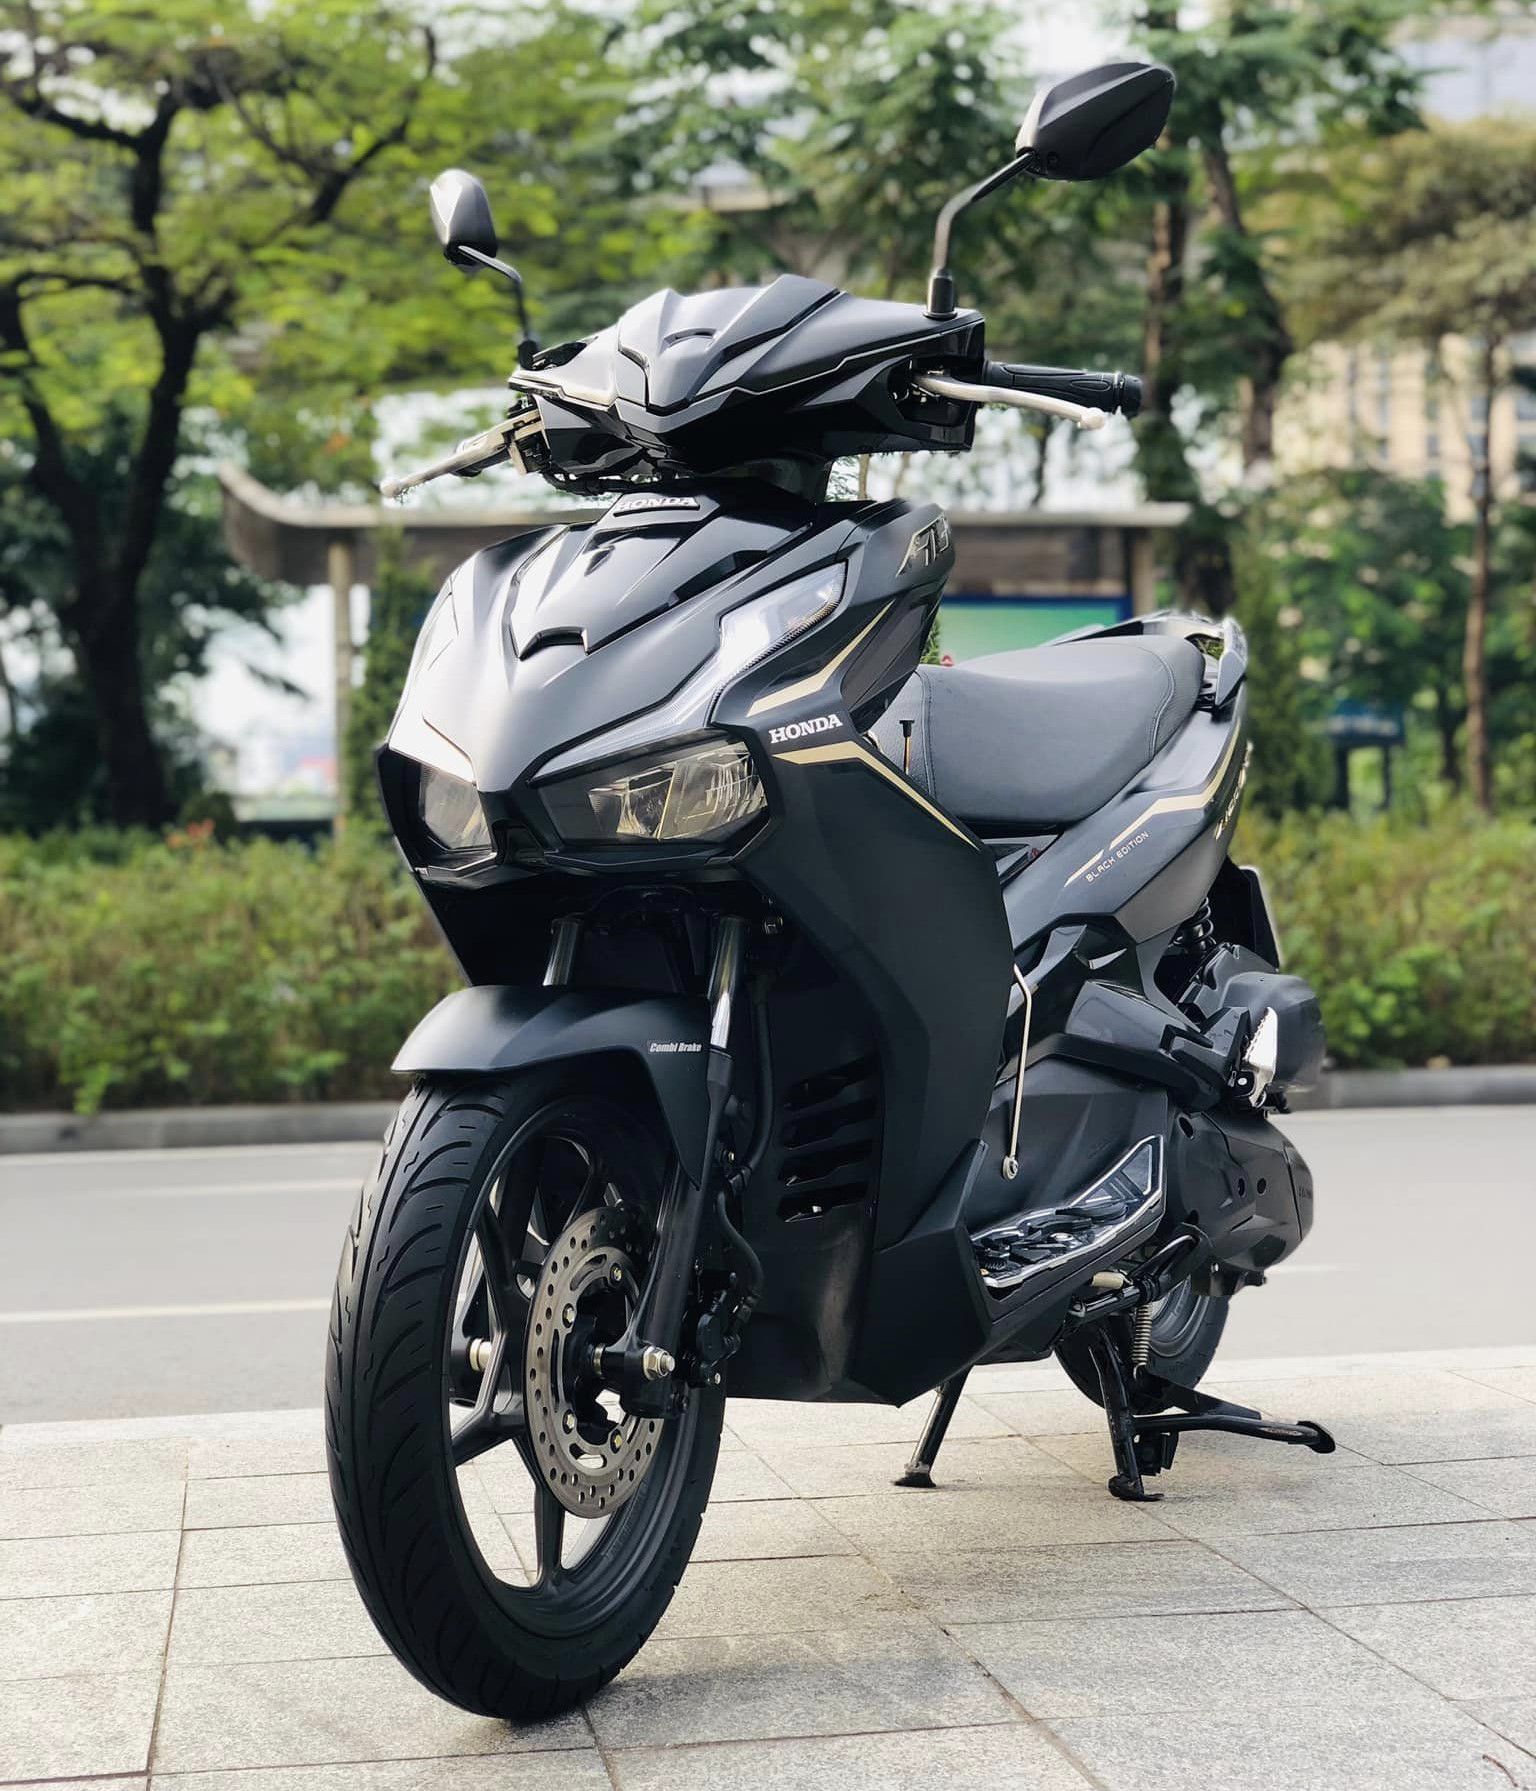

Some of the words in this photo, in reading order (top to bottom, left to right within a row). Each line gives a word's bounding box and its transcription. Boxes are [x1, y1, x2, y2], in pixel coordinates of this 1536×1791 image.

[615, 496, 699, 513] HONDA
[768, 713, 844, 744] HONDA
[1085, 856, 1116, 882] BLACK
[1116, 831, 1149, 859] EDITION
[649, 1042, 678, 1053] Combi
[678, 1042, 702, 1053] Brake
